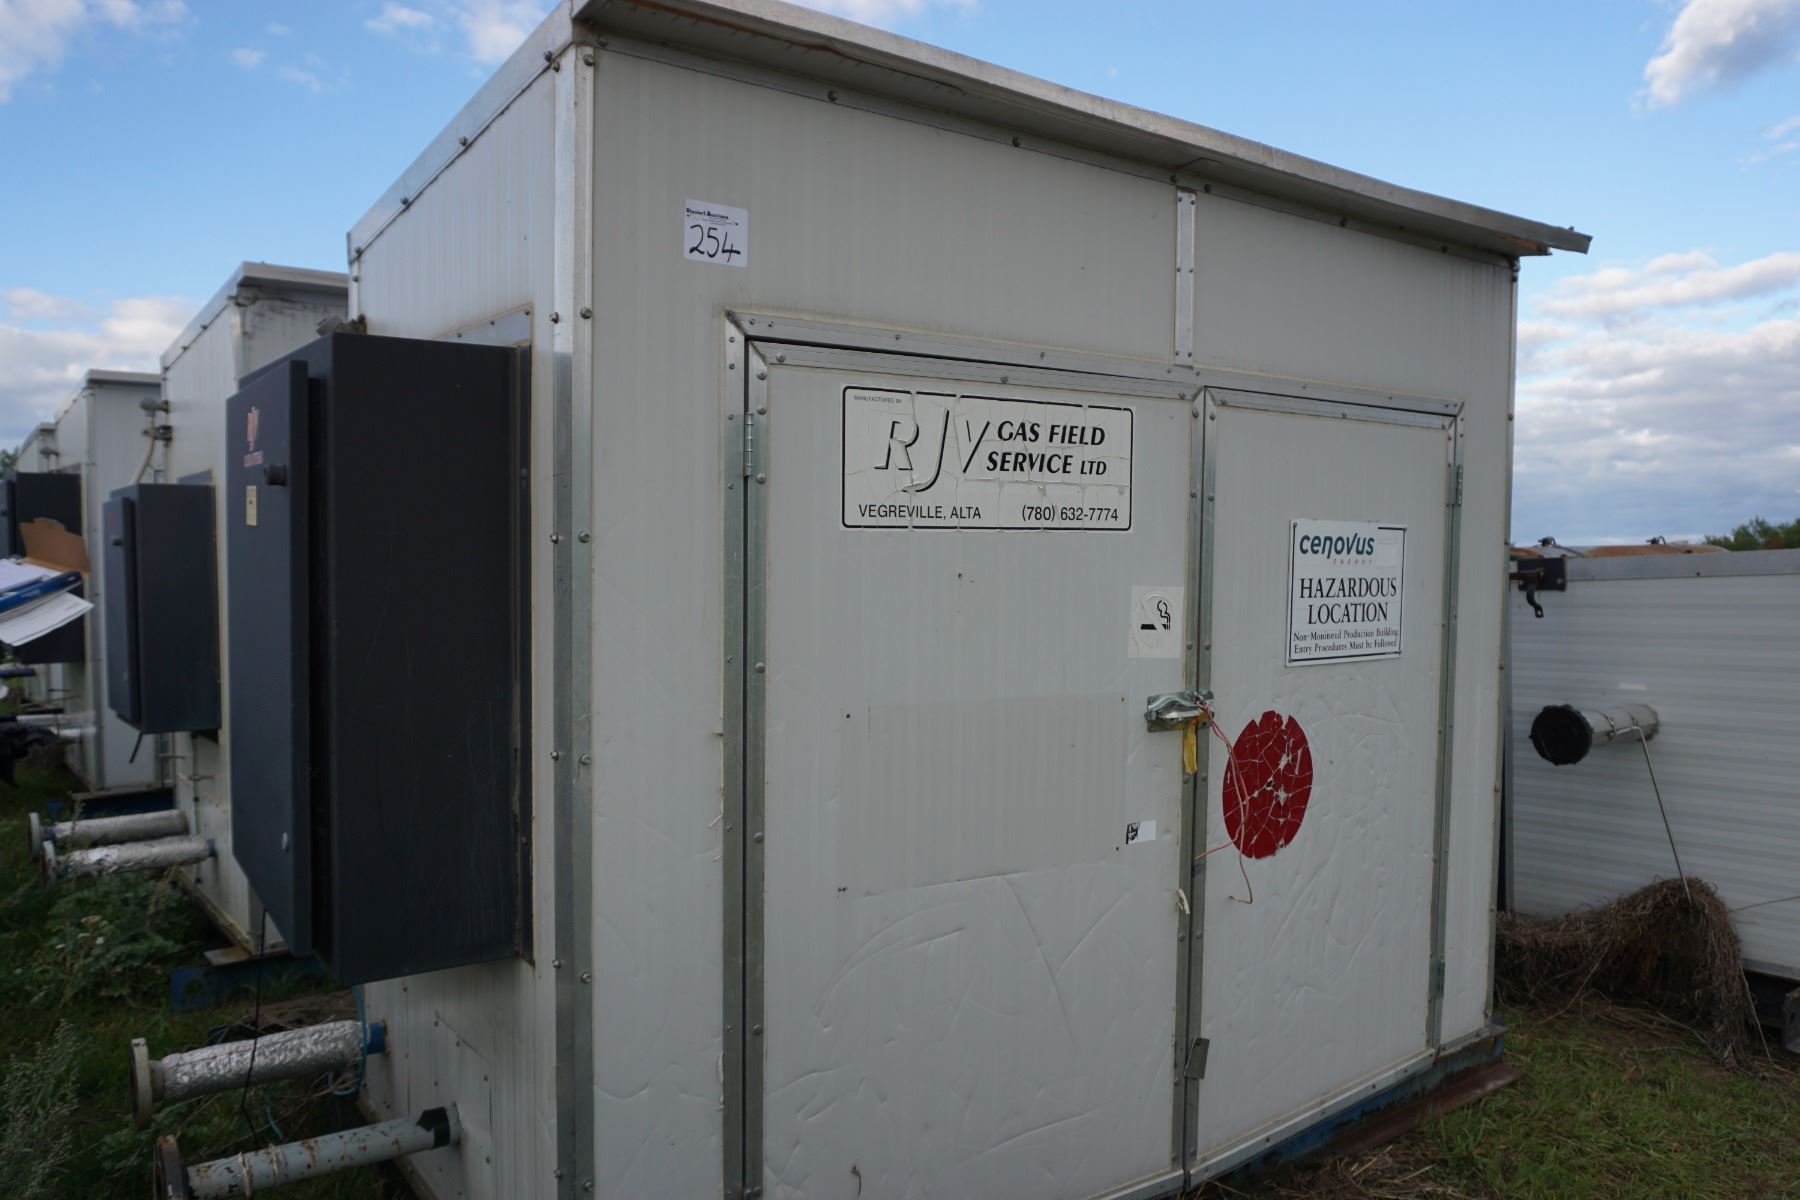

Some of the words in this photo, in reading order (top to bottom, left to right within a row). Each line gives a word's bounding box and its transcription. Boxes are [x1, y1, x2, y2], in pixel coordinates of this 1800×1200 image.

[689, 224, 741, 263] 254
[997, 420, 1041, 443] GAS
[1048, 423, 1106, 446] FIELD
[986, 451, 1074, 475] SERVICE
[1080, 460, 1107, 476] LTD
[858, 504, 947, 520] VEGREVILLE,
[950, 506, 981, 519] ALTA
[1021, 504, 1056, 522] (780)
[1060, 507, 1119, 522] 632-7774
[1299, 577, 1397, 599] HAZARDOUS
[1307, 602, 1388, 625] LOCATION
[1343, 628, 1375, 639] Production
[1376, 626, 1400, 638] Building
[1294, 643, 1313, 656] Entry
[1349, 640, 1364, 650] Must
[1366, 640, 1373, 648] be
